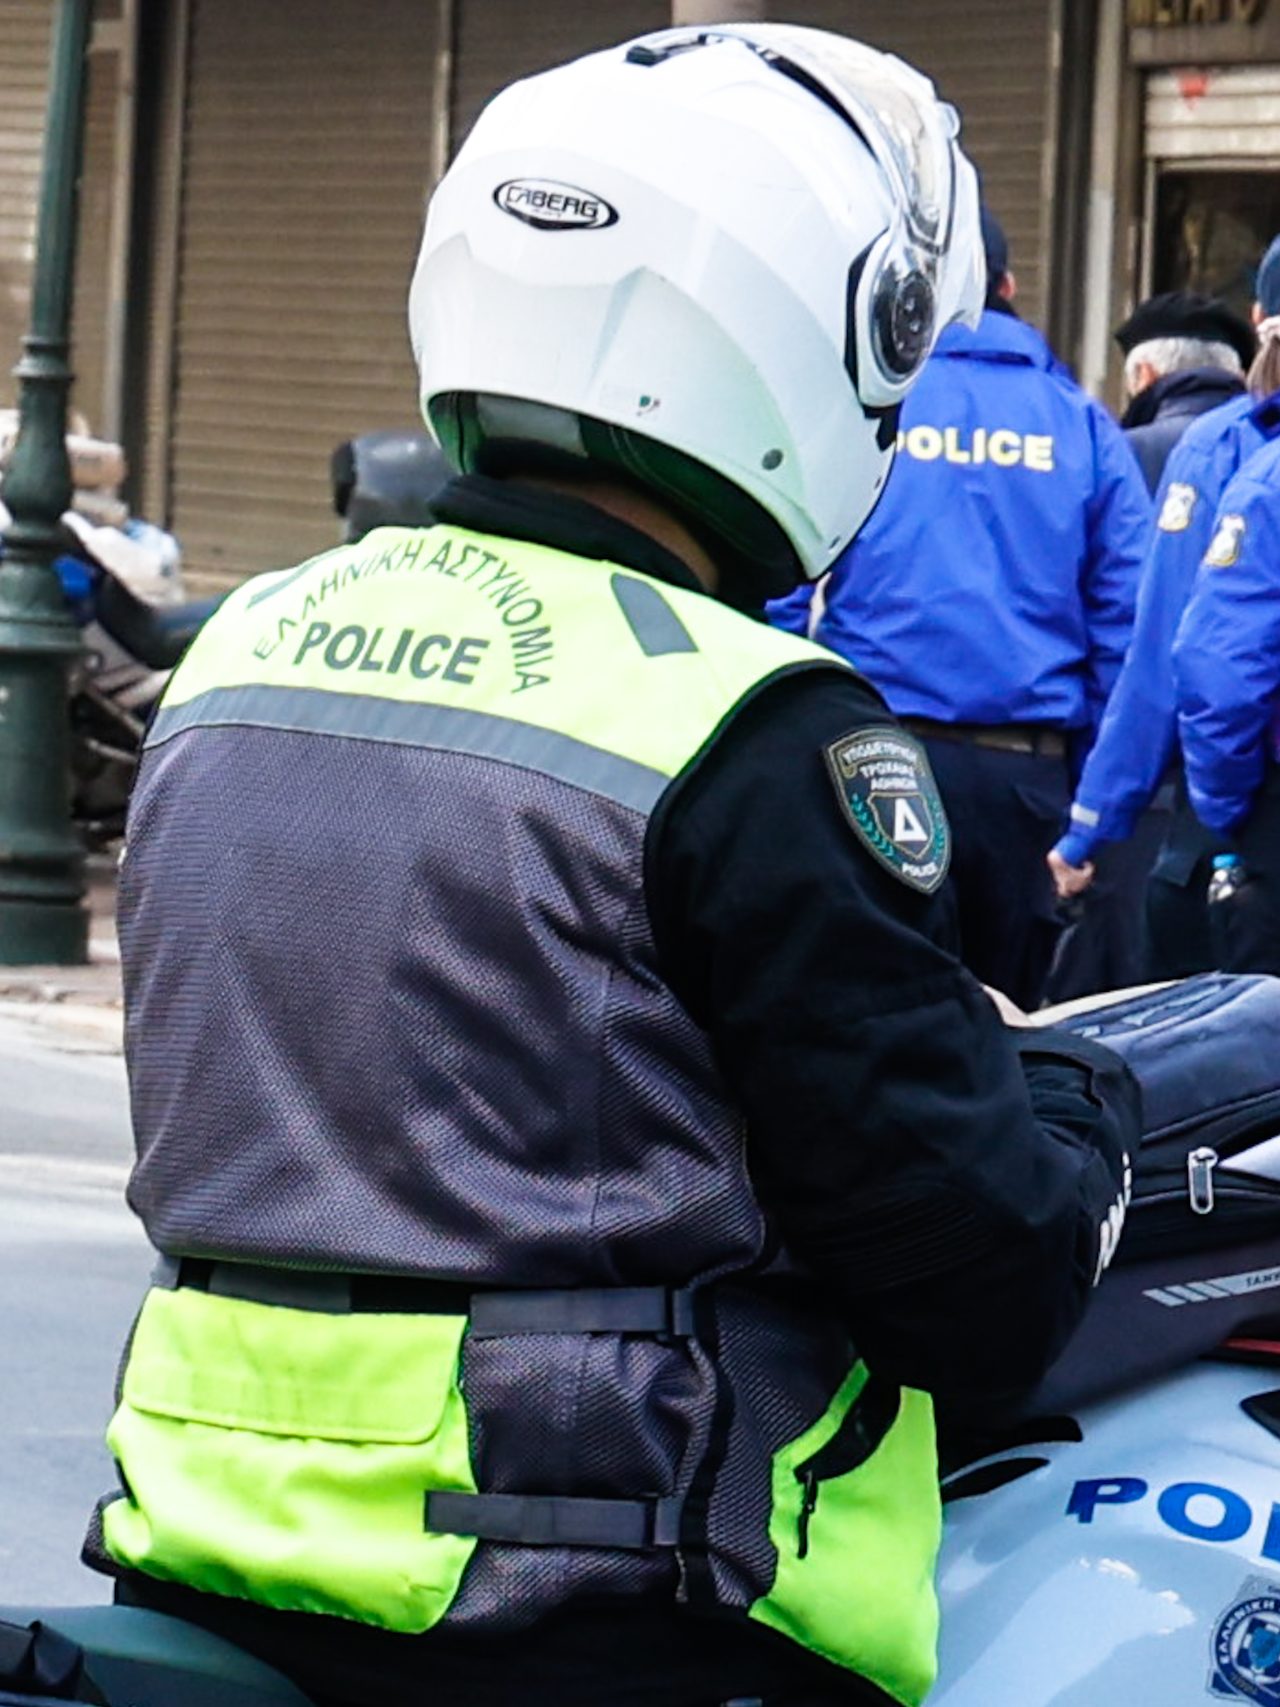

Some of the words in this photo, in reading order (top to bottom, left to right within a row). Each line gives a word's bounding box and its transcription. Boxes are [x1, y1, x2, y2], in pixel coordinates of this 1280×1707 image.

[506, 186, 599, 218] CABERG
[252, 538, 425, 660] ΕΛΛΗΝΙΚΗ
[424, 538, 554, 694] ΑΣΤΥΝΟΜΙΑ
[292, 621, 490, 685] POLICE
[894, 798, 928, 841] Δ
